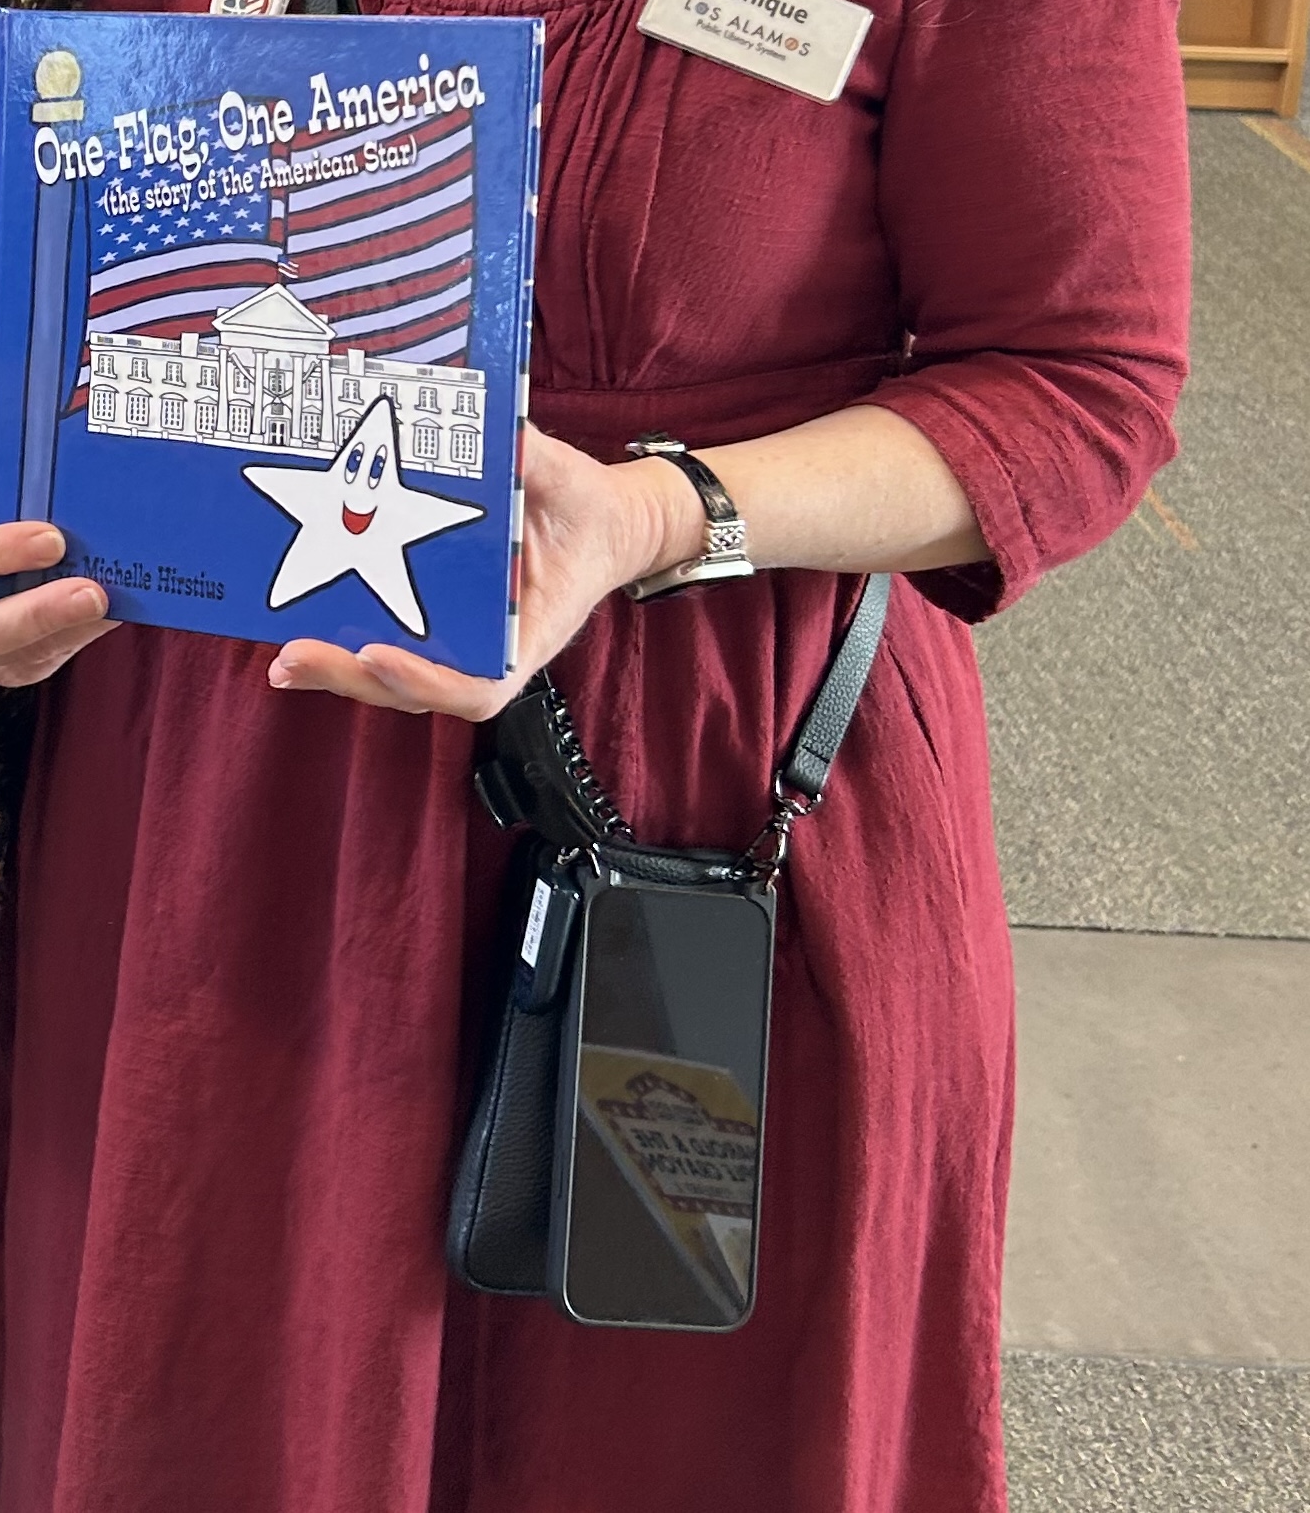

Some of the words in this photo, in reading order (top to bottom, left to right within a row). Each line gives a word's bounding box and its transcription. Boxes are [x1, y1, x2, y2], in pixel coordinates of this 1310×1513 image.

[696, 19, 722, 35] Public
[723, 29, 755, 51] Library
[755, 42, 787, 61] System
[33, 126, 106, 186] One
[113, 107, 211, 180] Flag,
[217, 89, 296, 151] One
[307, 52, 487, 134] America
[102, 185, 142, 217] (the
[143, 182, 194, 217] story
[199, 170, 218, 200] of
[223, 164, 254, 197] the
[259, 147, 359, 189] American
[362, 133, 422, 174] Star)
[82, 555, 153, 591] Michelle
[156, 565, 226, 601] Hirstius
